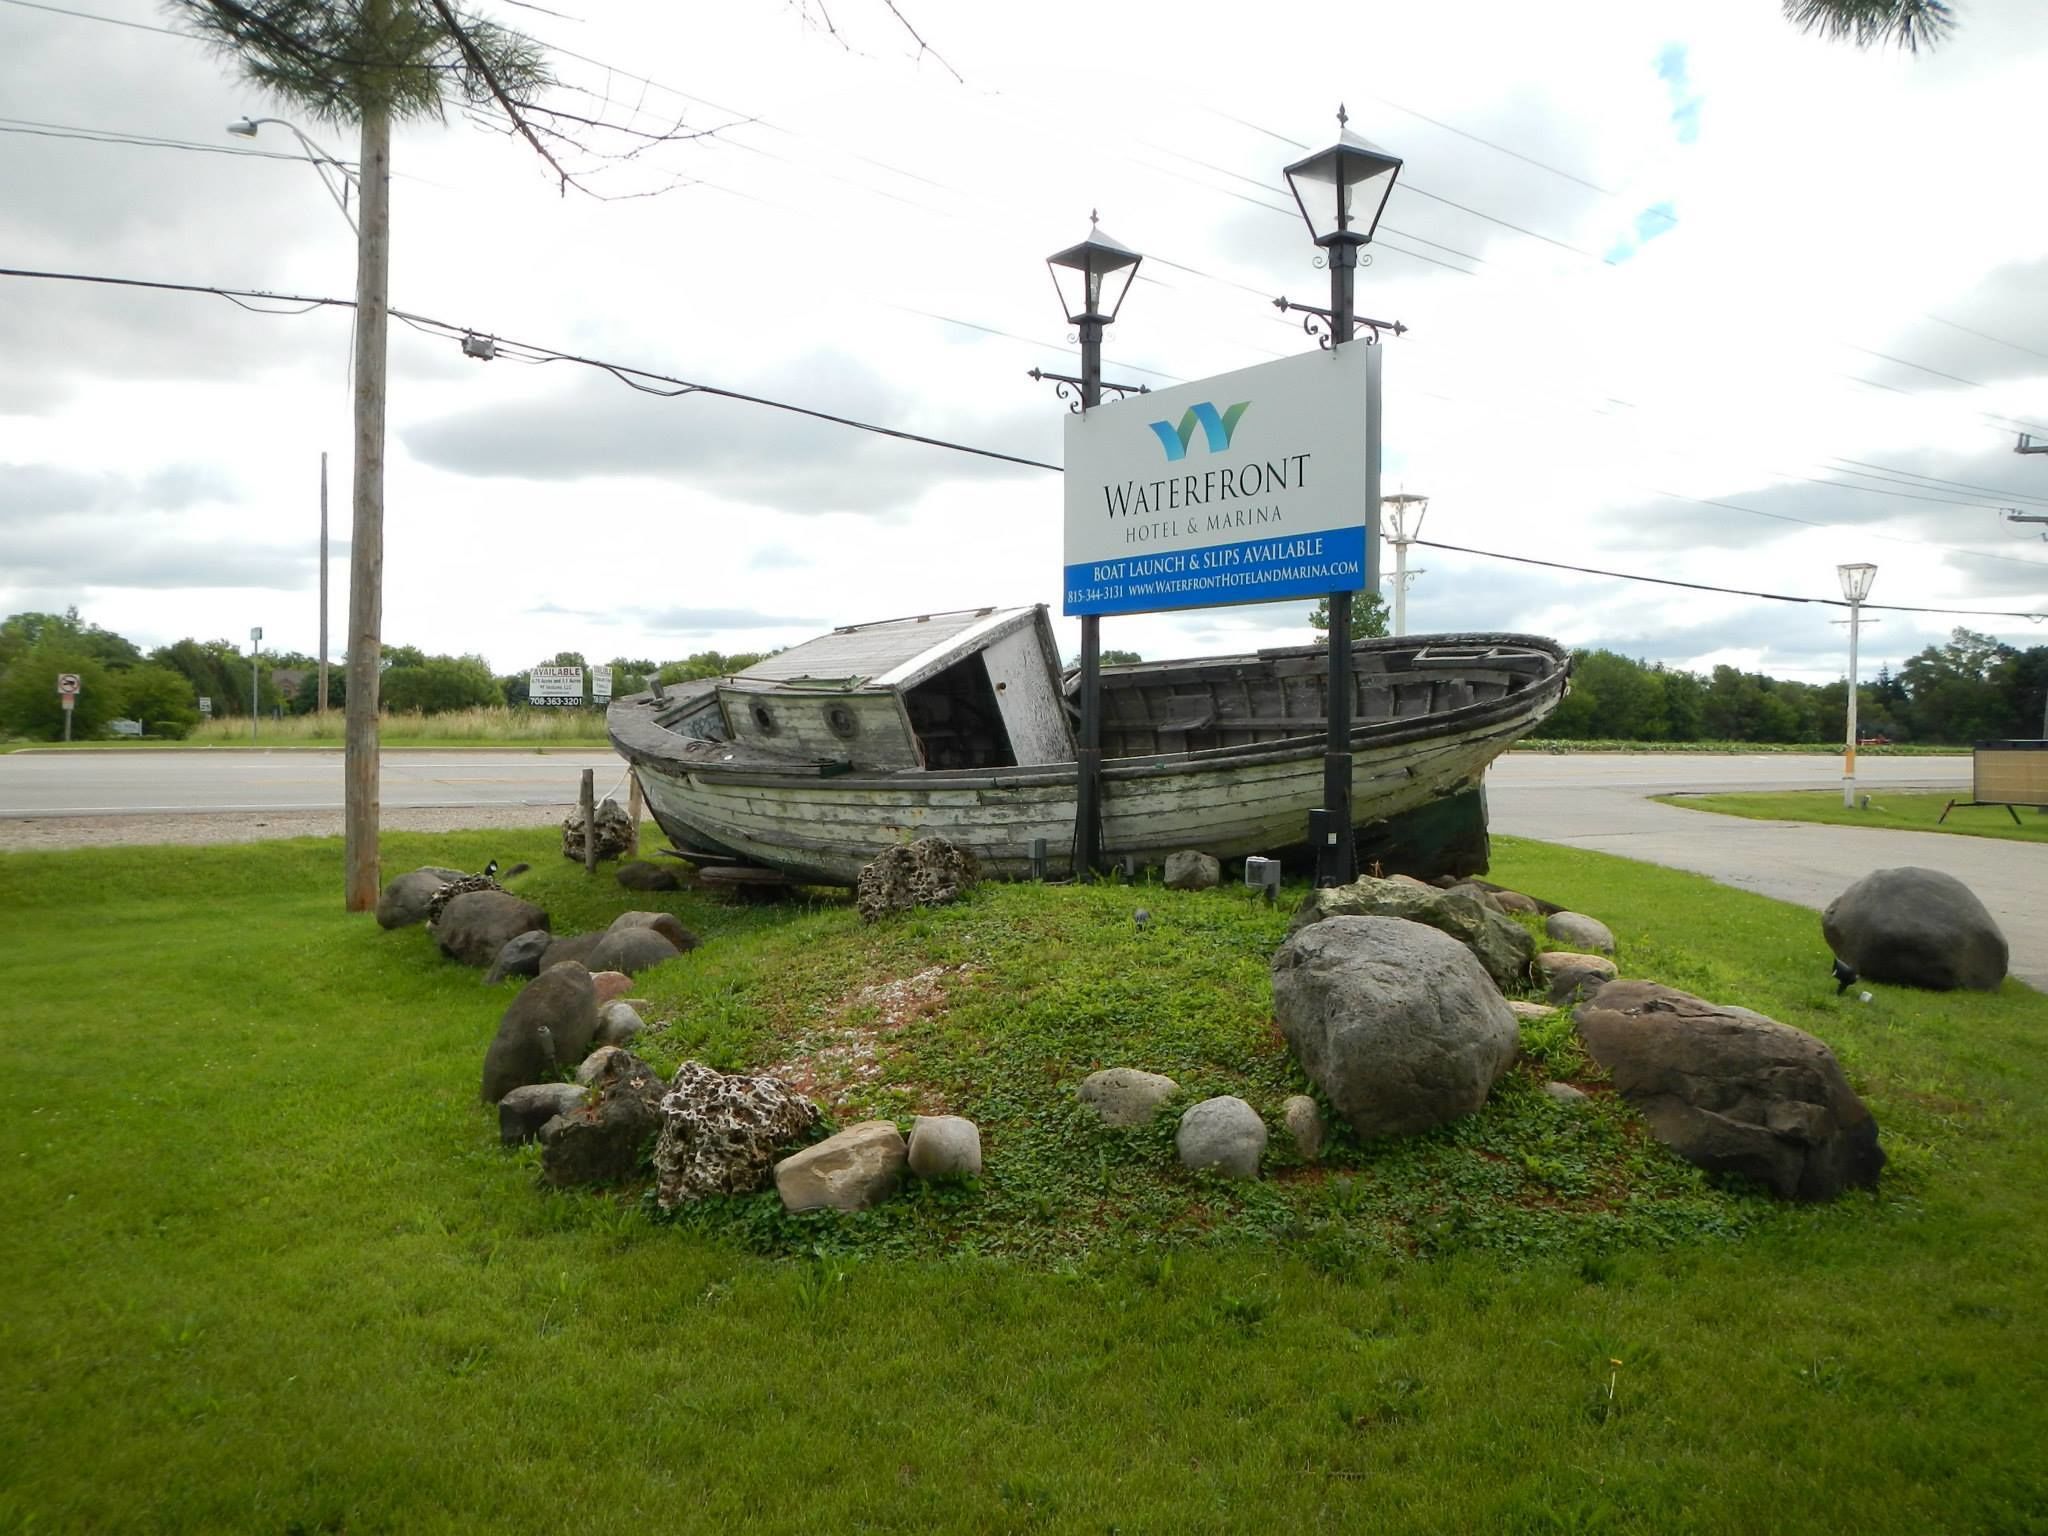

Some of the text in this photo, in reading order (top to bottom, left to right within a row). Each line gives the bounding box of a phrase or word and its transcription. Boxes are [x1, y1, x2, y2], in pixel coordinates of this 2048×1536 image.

[1104, 454, 1311, 519] WATERFRONT
[1125, 505, 1283, 544] HOTEL & MARINA
[1093, 537, 1324, 582] BOAT LAUNCH & SLIPS AVAILABLE
[1067, 585, 1124, 604] 815-344-3131
[533, 668, 580, 676] AVAILABLE
